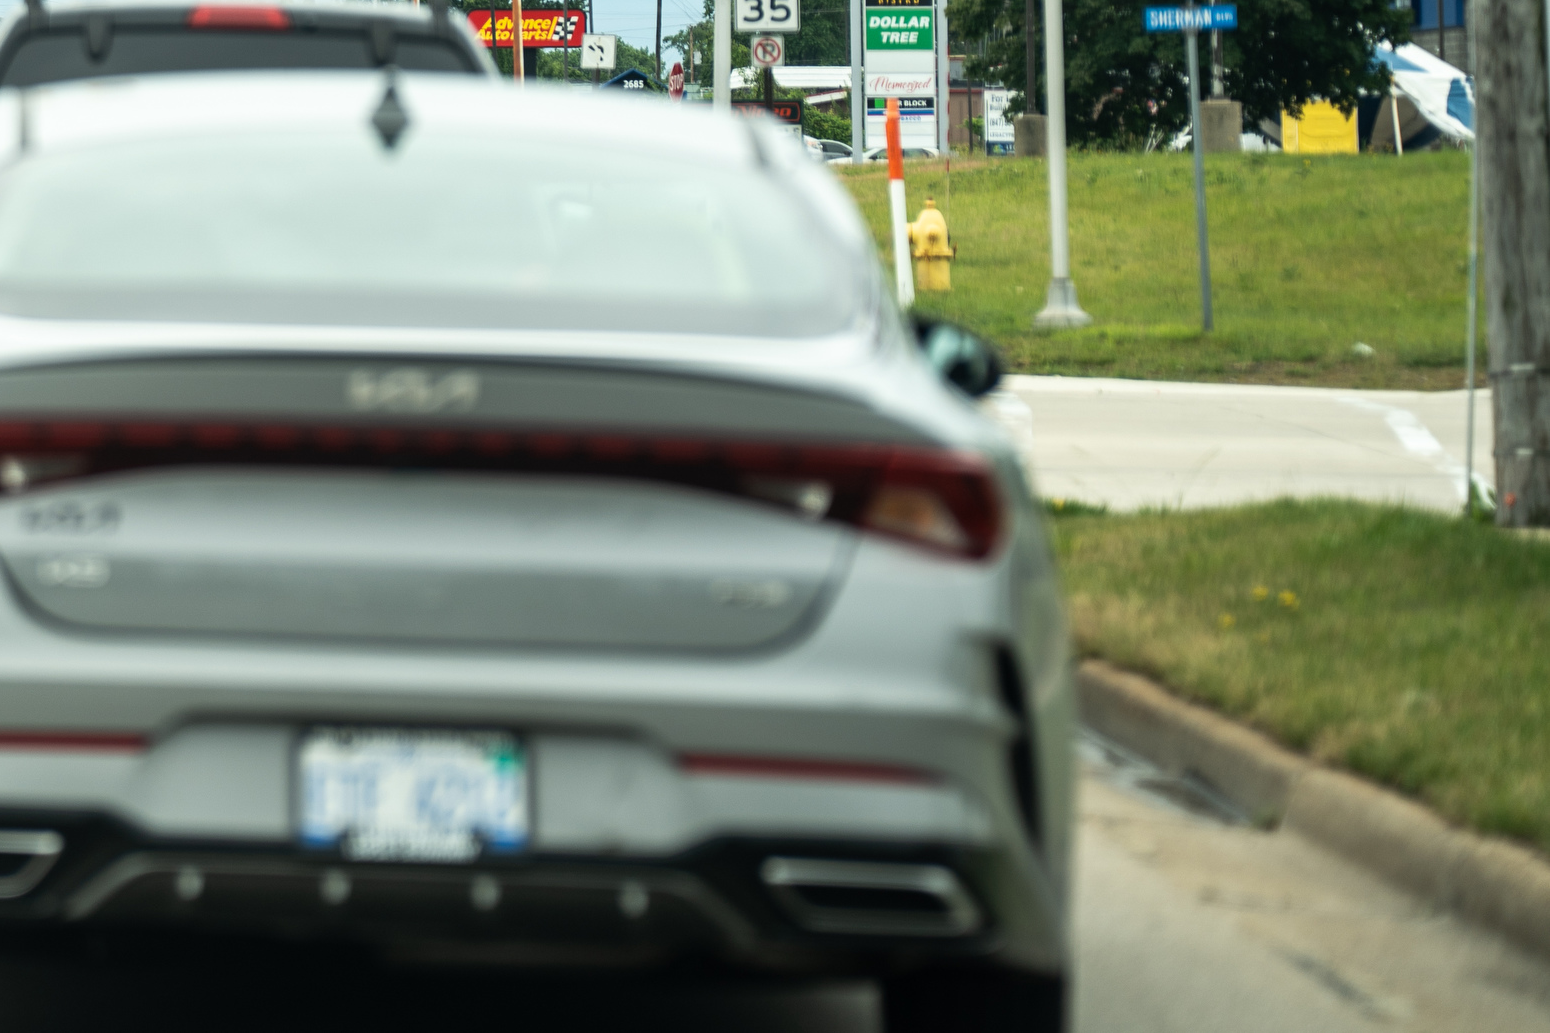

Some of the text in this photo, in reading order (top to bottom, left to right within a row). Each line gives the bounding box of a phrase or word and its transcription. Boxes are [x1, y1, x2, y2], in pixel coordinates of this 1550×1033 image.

[869, 16, 930, 29] DOLLAR
[1151, 9, 1212, 28] SHERMAN
[880, 31, 919, 44] TREE
[623, 79, 644, 89] 2685
[669, 73, 684, 92] STOP
